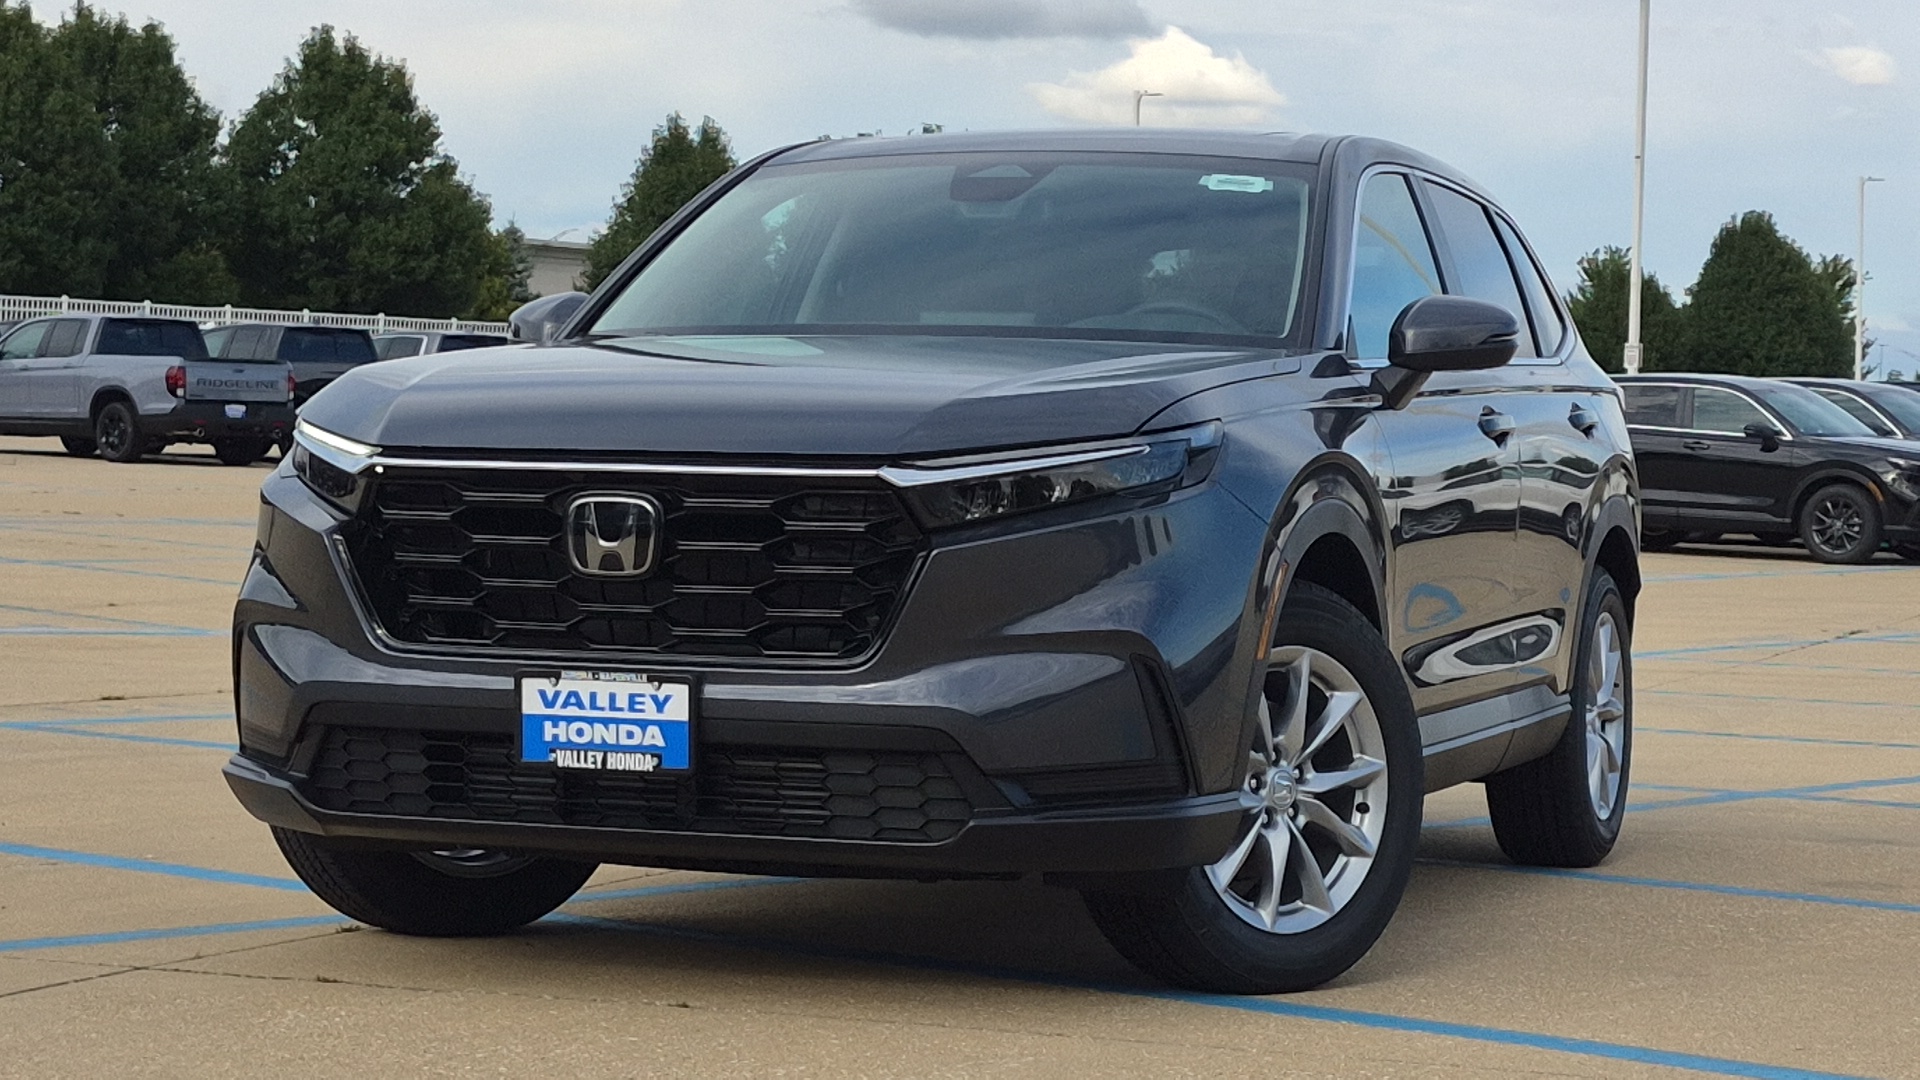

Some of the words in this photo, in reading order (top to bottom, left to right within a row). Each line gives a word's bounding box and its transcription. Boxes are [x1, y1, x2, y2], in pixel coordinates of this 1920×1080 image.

[196, 378, 279, 390] RIDGELINE
[537, 689, 673, 714] VALLEY
[543, 721, 666, 747] HONDA
[556, 750, 604, 769] VALLEY
[606, 752, 653, 772] HONDA
